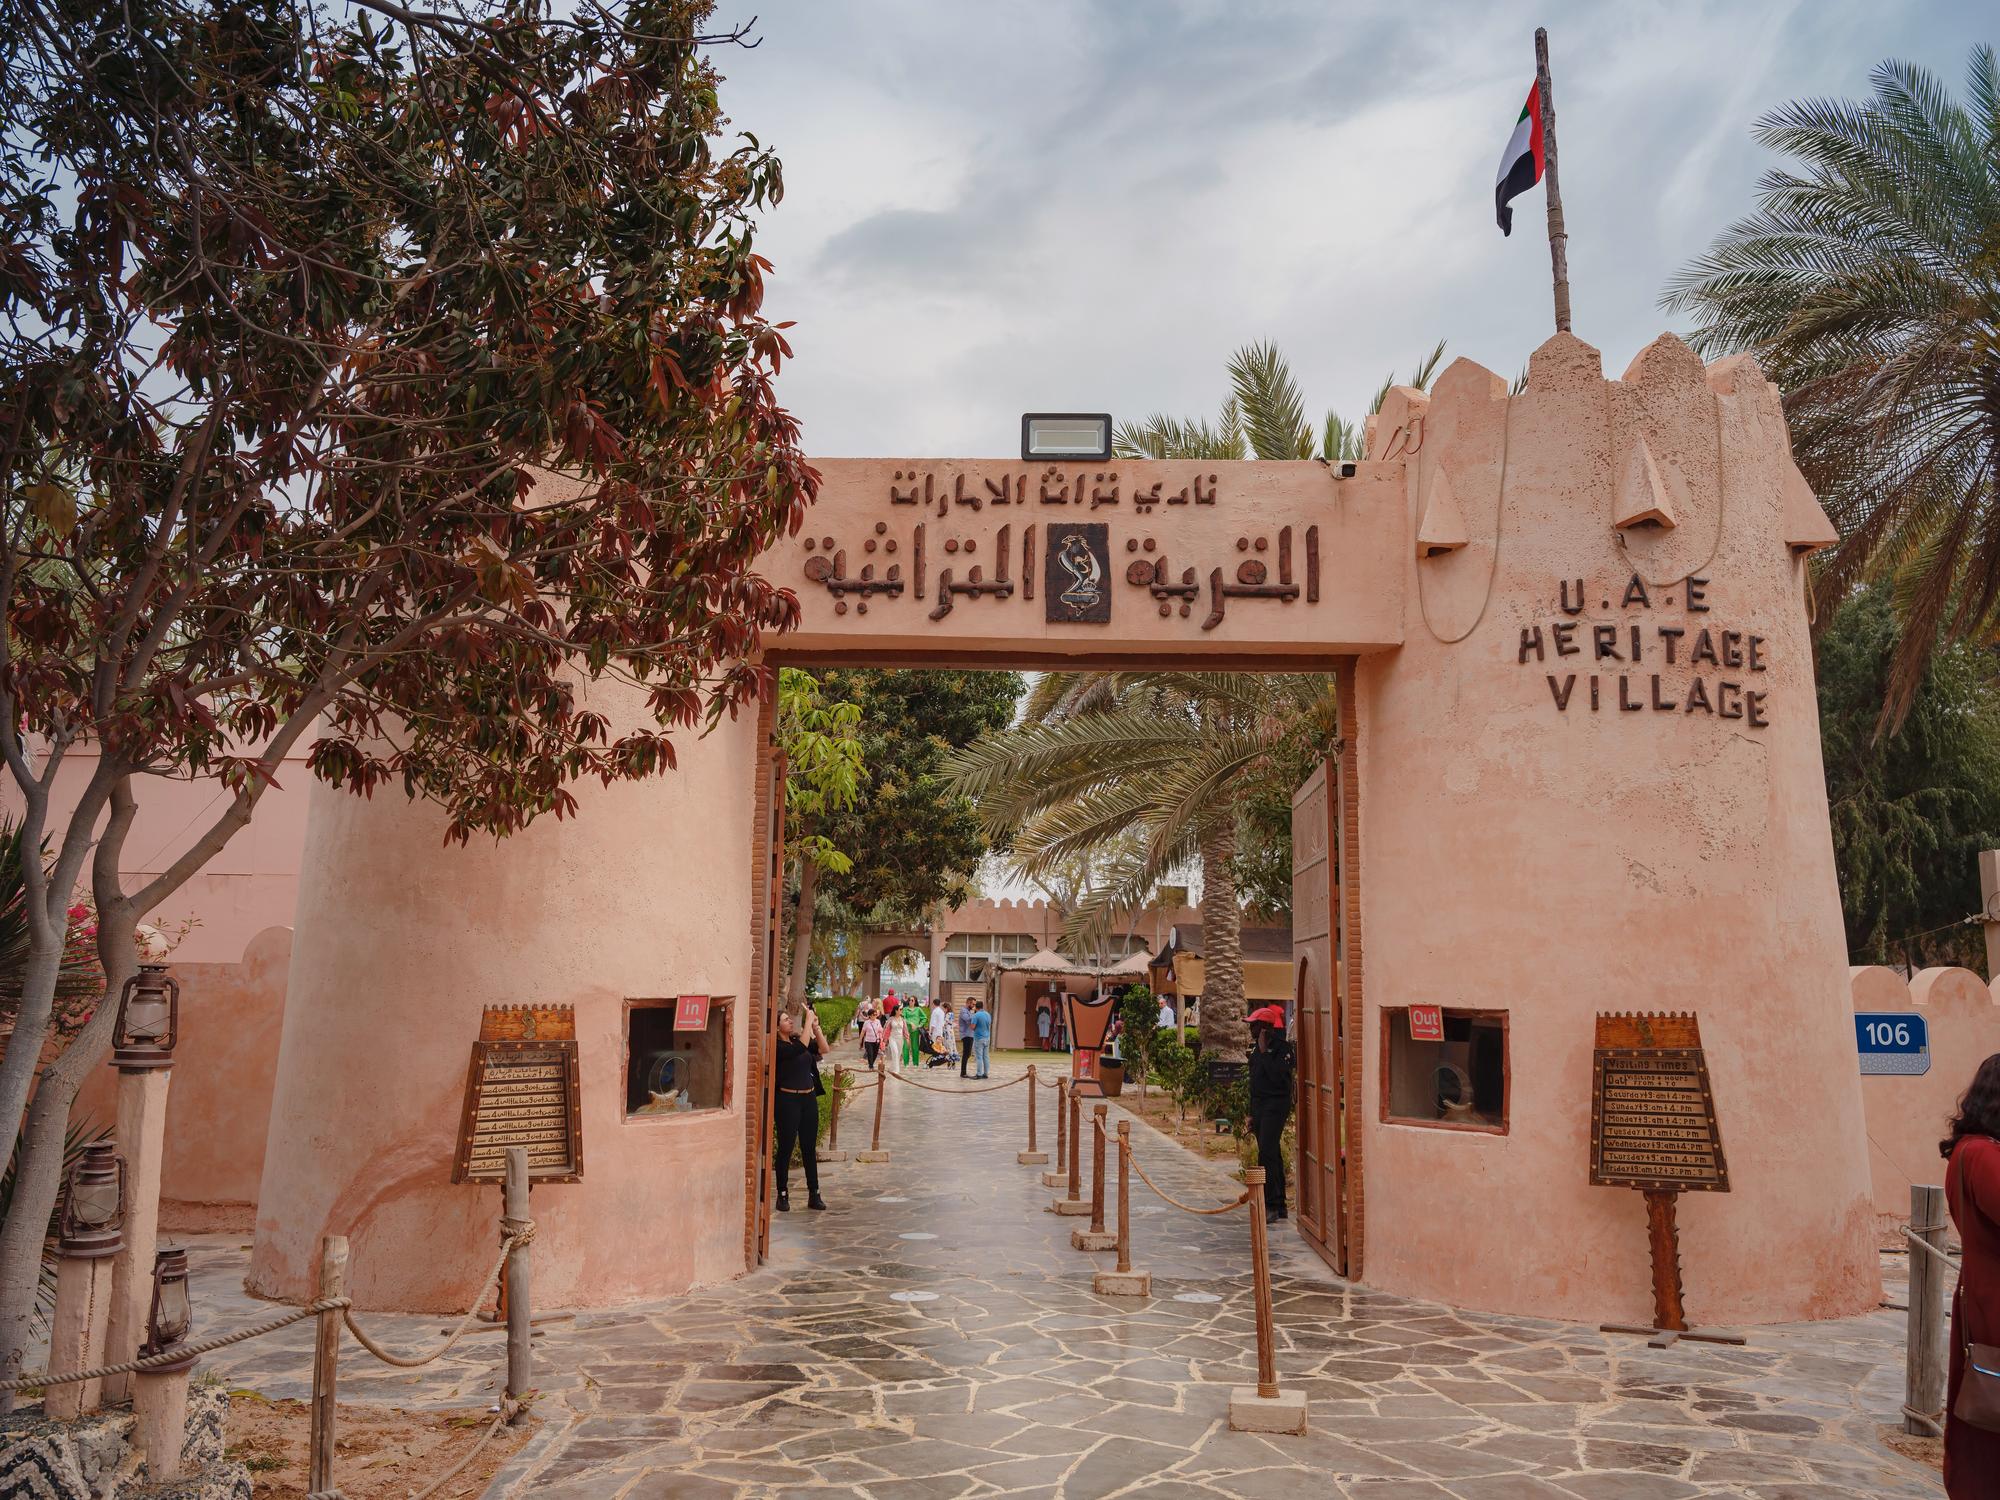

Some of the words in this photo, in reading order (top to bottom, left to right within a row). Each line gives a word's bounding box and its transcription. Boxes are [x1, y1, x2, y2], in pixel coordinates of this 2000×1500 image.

[803, 521, 1035, 622] التراثية
[1126, 525, 1320, 631] القرية
[1518, 622, 1767, 671] HERITAGE
[1546, 674, 1770, 728] VILLAGE
[1412, 1010, 1439, 1026] Out
[1865, 1022, 1910, 1046] 106
[1608, 1090, 1644, 1098] Saturday
[1608, 1115, 1638, 1123] Monday
[1608, 1128, 1640, 1136] Tuesday
[1606, 1139, 1650, 1148] Wednesday
[1608, 1152, 1644, 1161] Thursday
